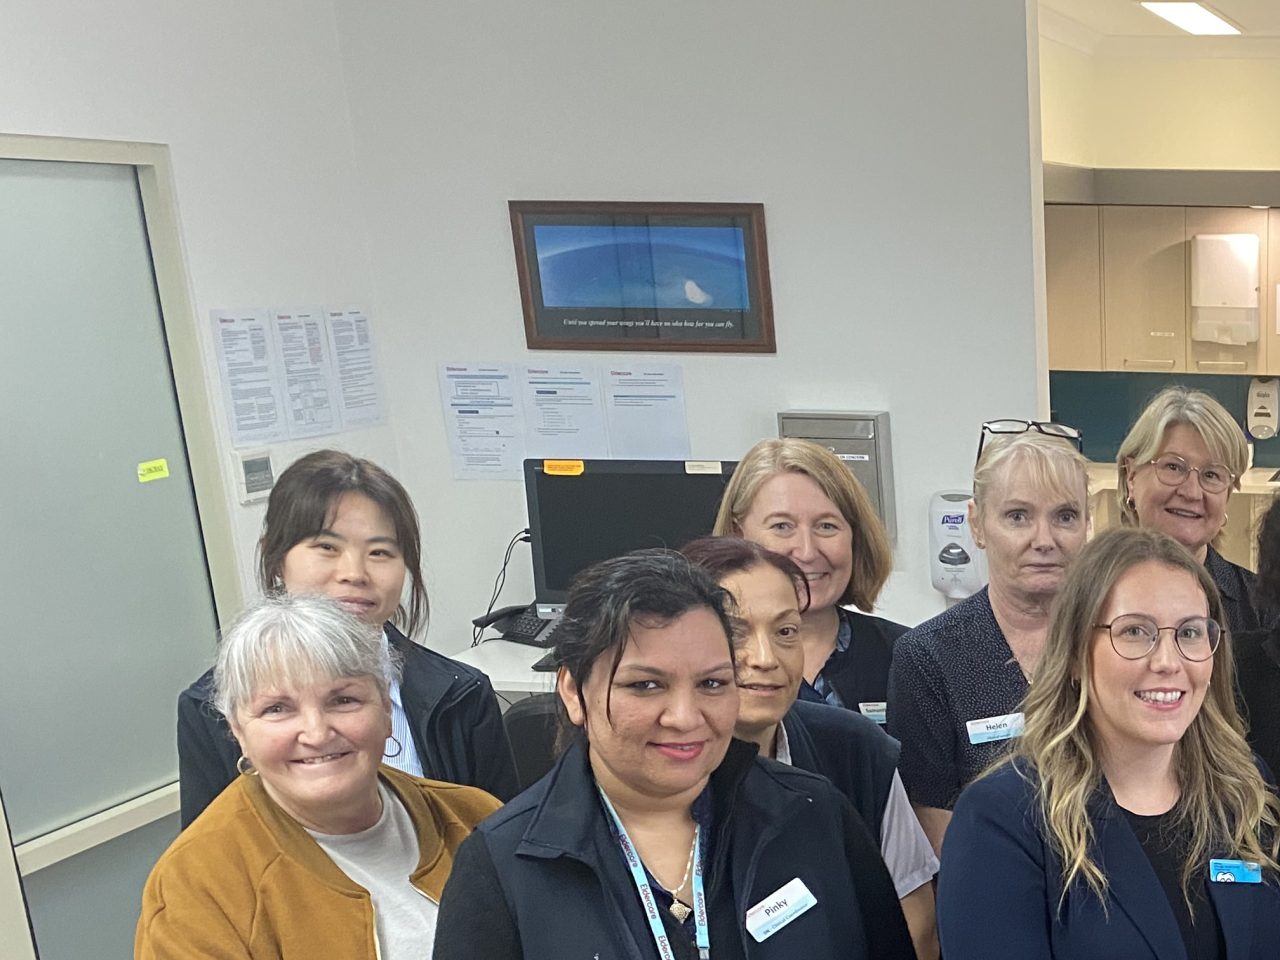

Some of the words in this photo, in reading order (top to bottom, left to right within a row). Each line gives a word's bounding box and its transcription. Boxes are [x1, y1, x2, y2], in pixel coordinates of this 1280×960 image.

[986, 722, 1008, 731] Helen
[640, 883, 657, 920] Eldercare
[698, 891, 706, 927] Eldercare
[764, 898, 788, 917] Pinky
